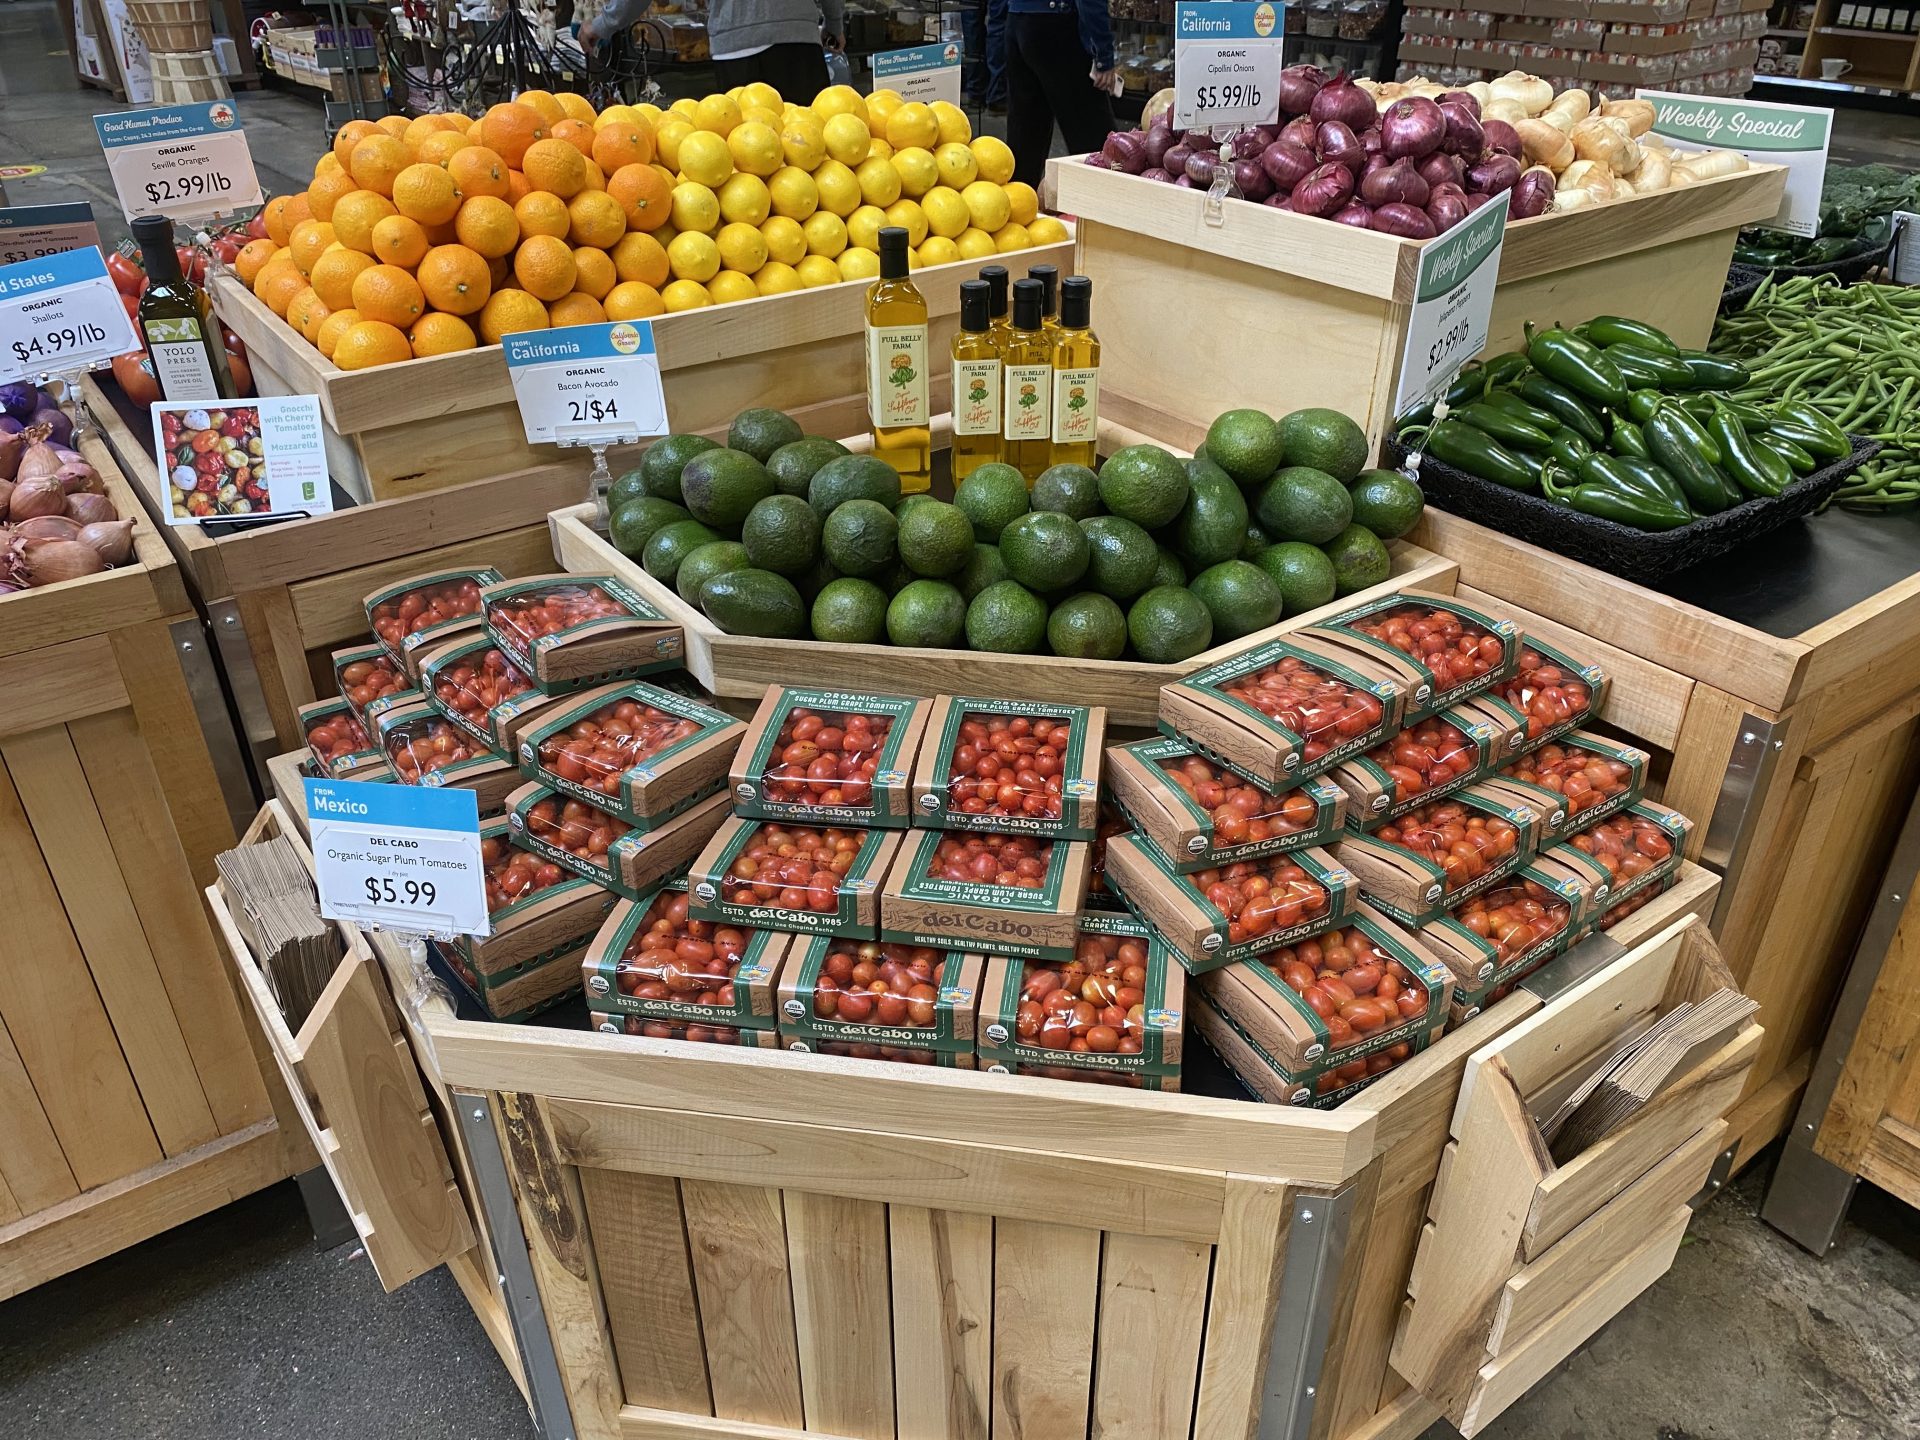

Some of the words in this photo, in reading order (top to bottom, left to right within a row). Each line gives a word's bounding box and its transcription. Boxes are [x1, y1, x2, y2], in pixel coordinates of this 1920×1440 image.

[1182, 18, 1231, 31] California
[909, 52, 923, 61] Farm
[1208, 64, 1232, 75] Cipollini
[1234, 64, 1255, 73] Onions
[918, 87, 936, 95] Lemons
[1197, 84, 1261, 111] $5.99/lb
[104, 121, 124, 132] Good
[124, 120, 150, 129] Humus
[151, 114, 182, 126] Produce
[212, 115, 233, 123] LOCAL
[1657, 104, 1723, 139] Weekly
[1727, 111, 1805, 139] Special
[158, 145, 195, 156] ORGANIC
[152, 161, 176, 170] Seville
[178, 156, 210, 166] Oranges
[145, 172, 231, 204] $2.99/lb
[1429, 240, 1464, 285] Weekly
[1463, 212, 1499, 266] Special
[9, 272, 55, 291] States
[1448, 282, 1468, 304] ORGANIC
[22, 298, 62, 312] ORGANIC
[1456, 292, 1471, 310] Peppers
[32, 312, 64, 324] Shallots
[12, 323, 106, 362] $4.99/lb
[1428, 316, 1468, 374] $2.99/lb
[164, 347, 194, 356] YOLO
[512, 342, 580, 360] California
[566, 368, 605, 376] ORGANIC
[558, 383, 582, 391] Bacon
[584, 379, 619, 388] Avocado
[280, 404, 313, 413] Gnocchi
[568, 399, 618, 422] 2/$4
[905, 404, 916, 414] Oil
[264, 416, 282, 424] with
[284, 413, 314, 423] Cherry
[274, 423, 316, 432] Tomatoes
[271, 442, 318, 452] Mozzarella
[1210, 652, 1255, 673] ORGANIC
[794, 696, 816, 704] SUGAR
[841, 700, 863, 708] GRAPE
[865, 702, 902, 710] TOMATOES
[823, 692, 878, 702] ORGANIC
[314, 788, 335, 796] FROM:
[314, 796, 368, 815] Mexico
[608, 799, 622, 810] 1985
[762, 804, 786, 812] ESTD.
[1301, 831, 1319, 840] 1985
[370, 838, 388, 846] DEL
[391, 840, 418, 848] CABO
[328, 849, 364, 862] Organic
[367, 852, 391, 865] Sugar
[395, 854, 417, 866] Plum
[420, 857, 467, 870] Tomatoes
[365, 877, 436, 906] $5.99
[918, 882, 962, 891] TOMATOES
[965, 886, 990, 894] GRAPE
[948, 892, 1010, 903] ORGANIC
[1017, 892, 1044, 900] SUGAR
[722, 907, 746, 916] ESTD.
[822, 918, 842, 926] 1985
[1226, 948, 1248, 958] ESTD.
[1313, 919, 1330, 930] 1985
[915, 936, 936, 944] HEALTHY
[954, 939, 975, 948] HEALTHY
[998, 945, 1020, 953] HEALTHY
[1021, 947, 1039, 955] PEOPLE
[617, 999, 641, 1008] ESTD.
[716, 1009, 737, 1017] 1985
[812, 1024, 837, 1032] ESTD.
[917, 1032, 937, 1040] 1985
[1326, 1053, 1346, 1066] ESTD.
[1411, 1019, 1427, 1031] 1985
[1014, 1048, 1040, 1058] ESTD.
